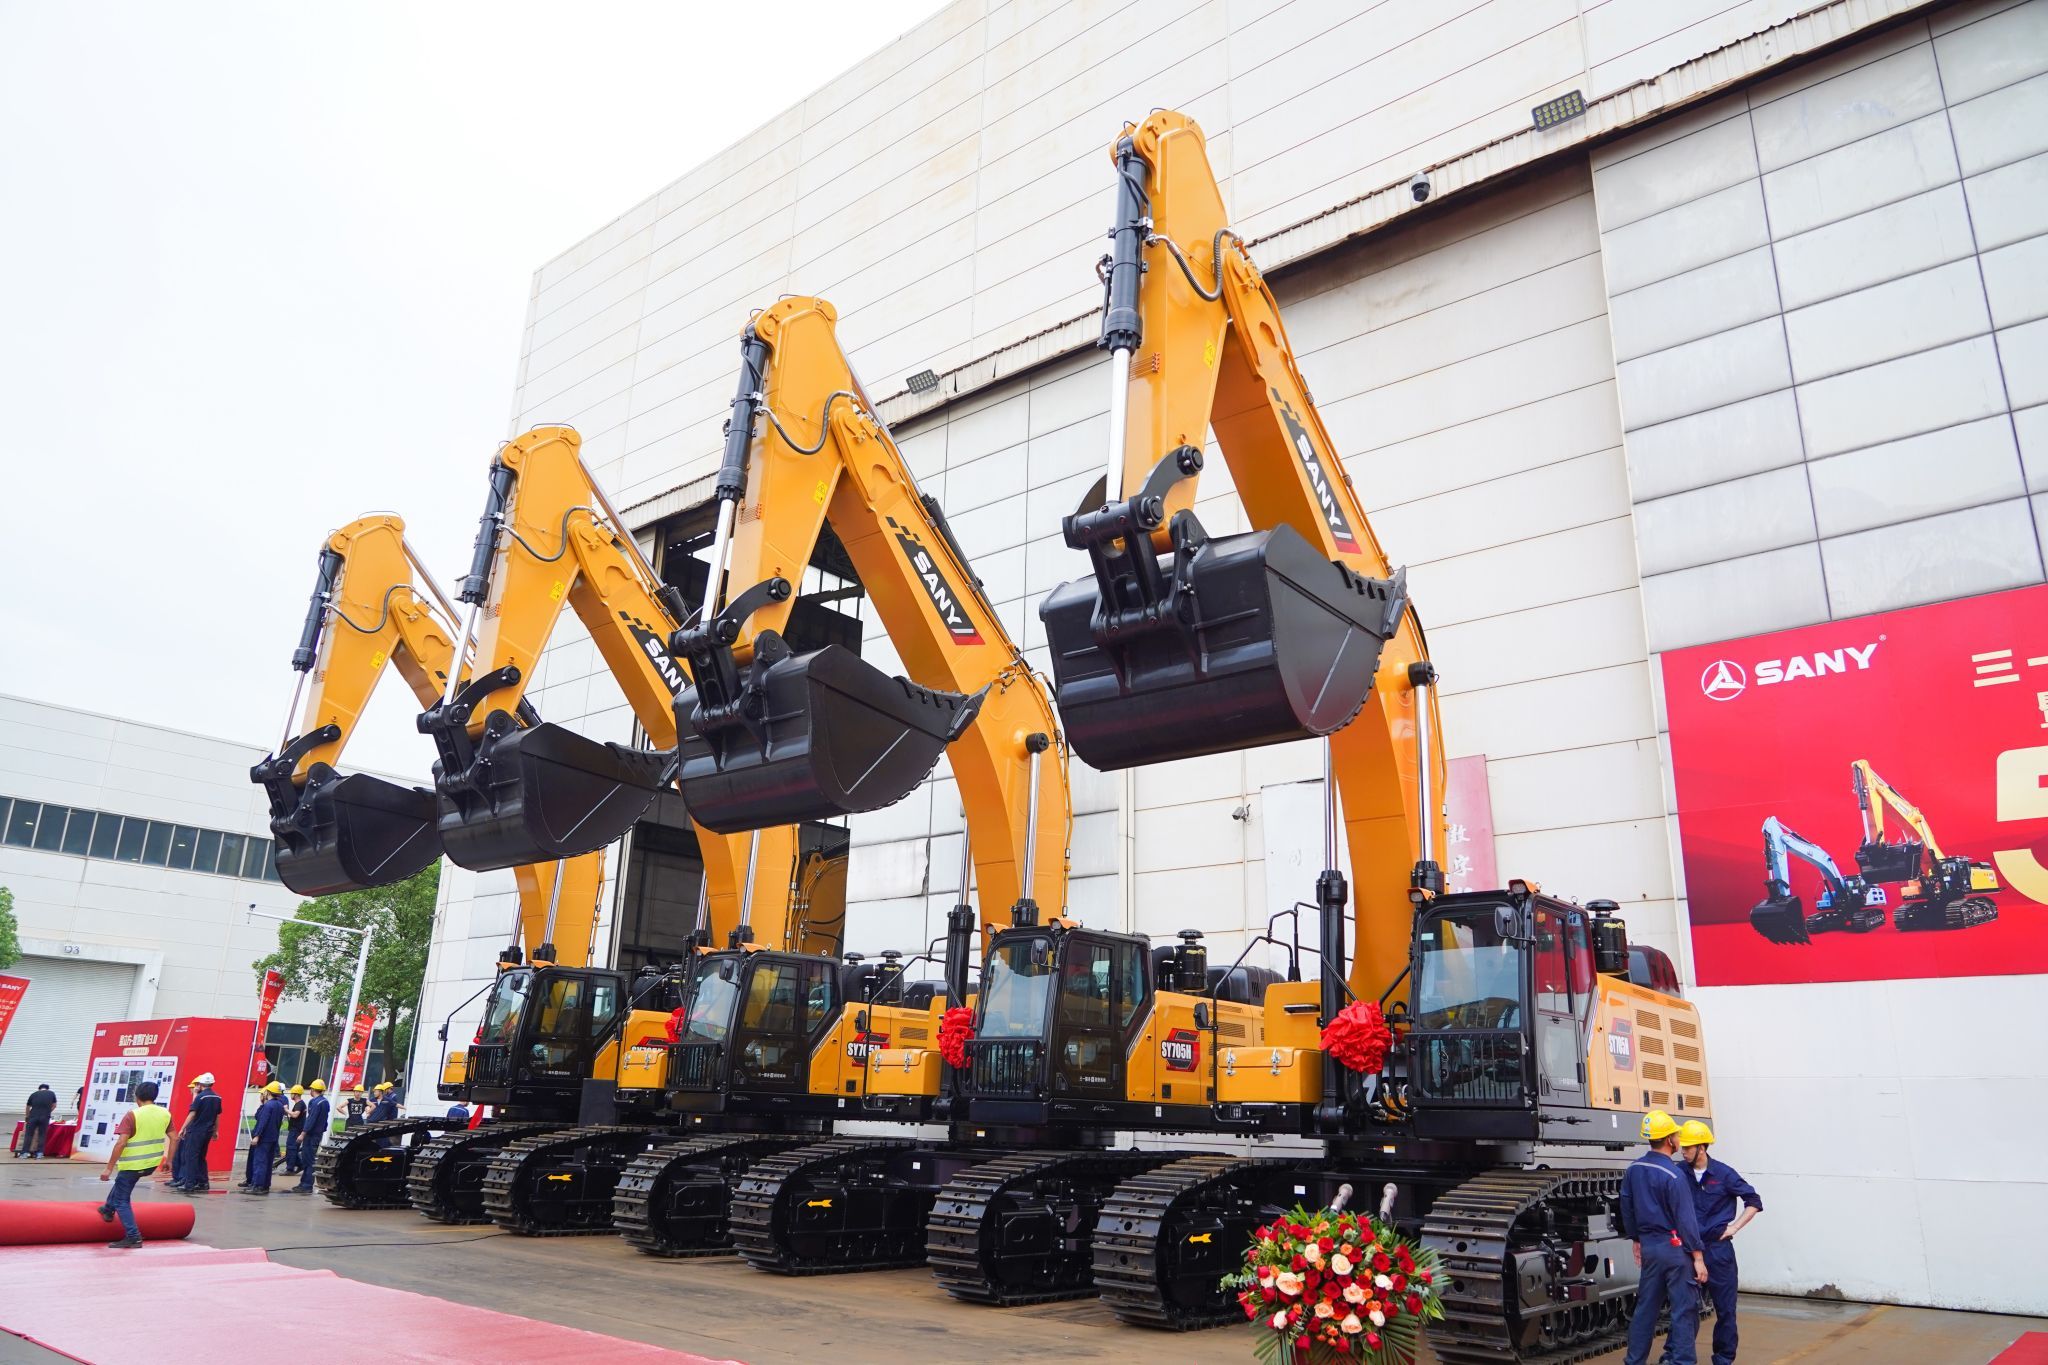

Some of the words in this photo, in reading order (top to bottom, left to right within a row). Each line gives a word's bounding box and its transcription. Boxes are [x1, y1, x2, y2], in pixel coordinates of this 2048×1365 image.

[1296, 433, 1342, 526] SANY
[912, 550, 963, 626] SANY
[1755, 642, 1878, 686] SANY
[1161, 1041, 1192, 1059] SY705H
